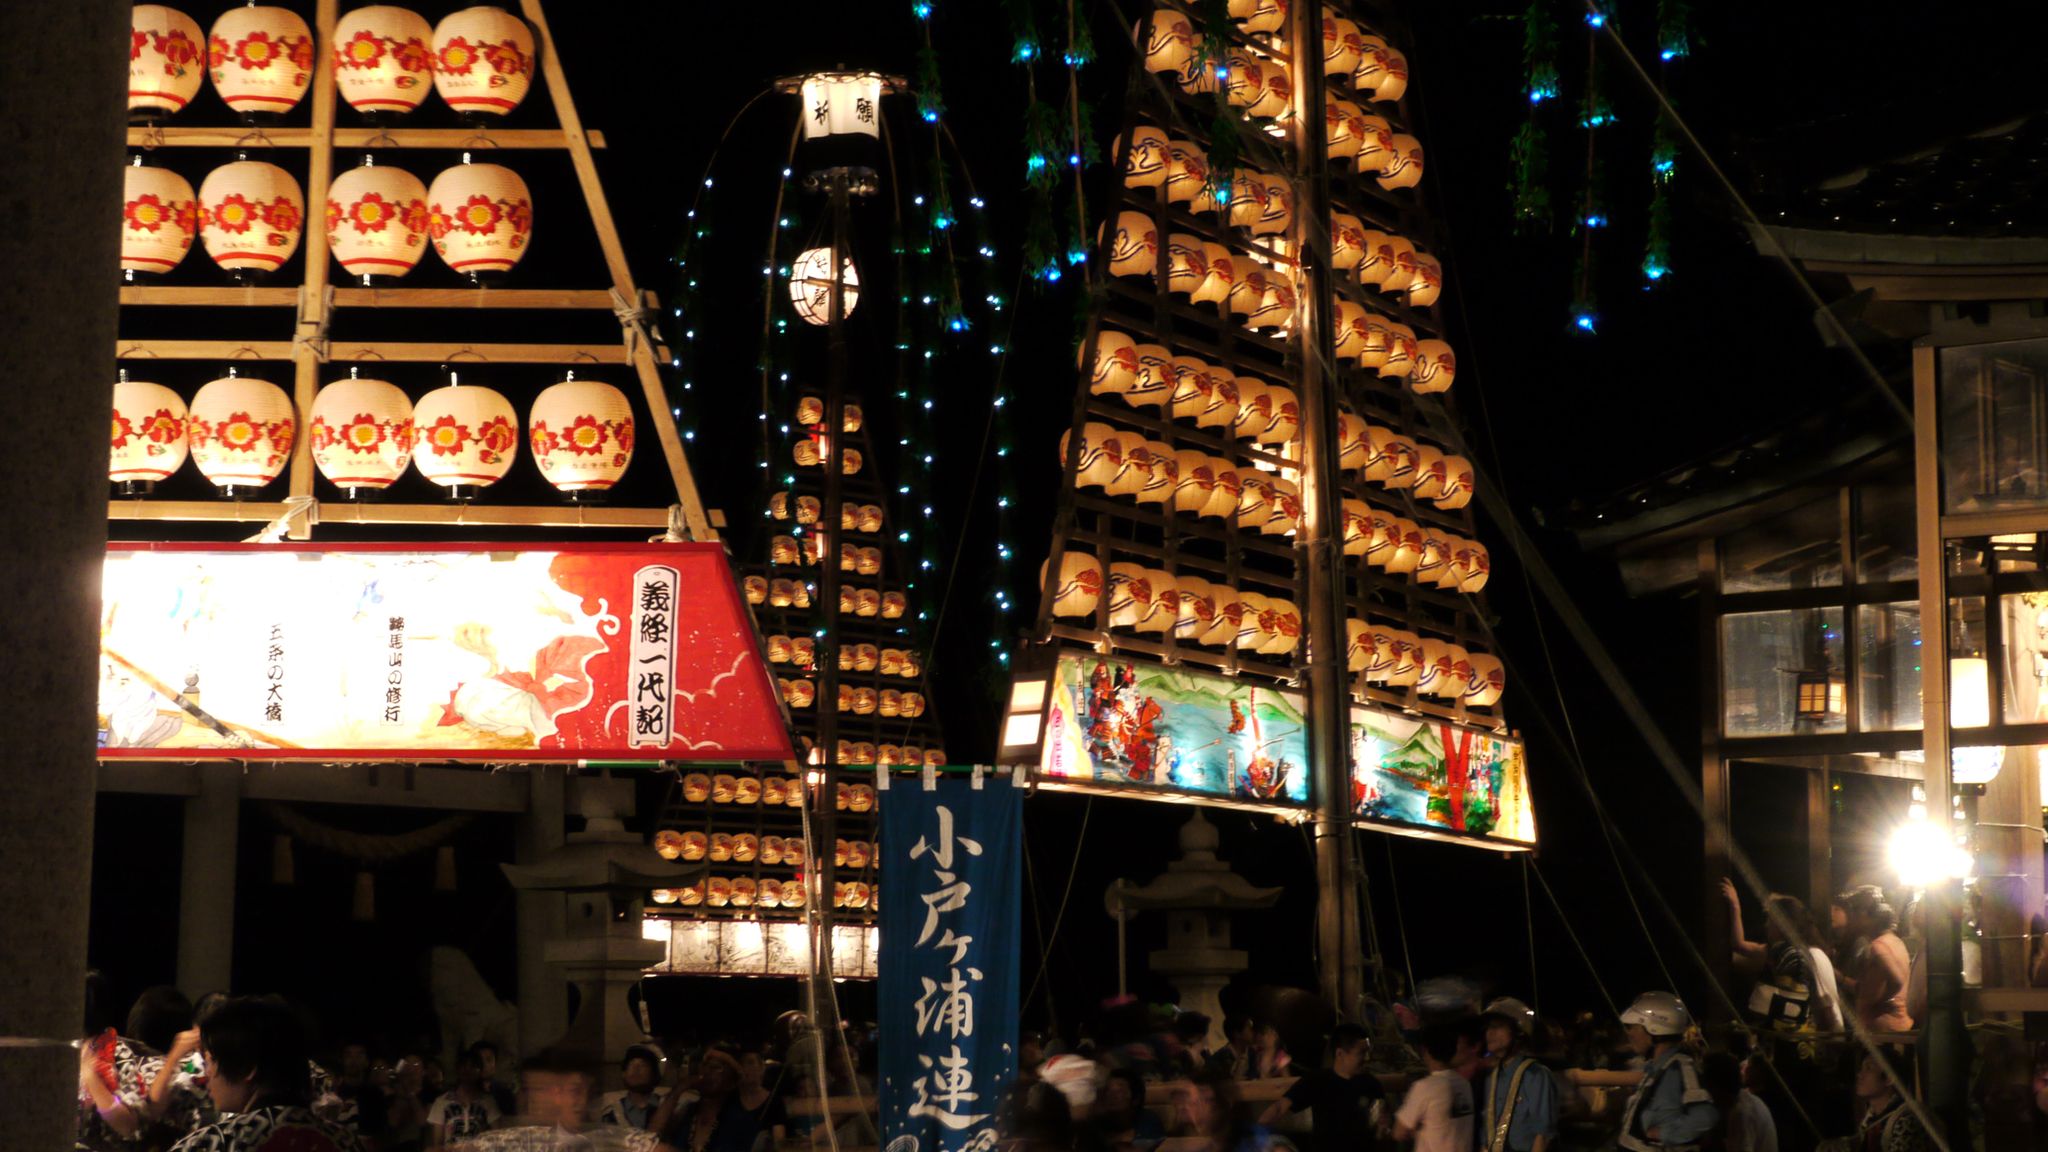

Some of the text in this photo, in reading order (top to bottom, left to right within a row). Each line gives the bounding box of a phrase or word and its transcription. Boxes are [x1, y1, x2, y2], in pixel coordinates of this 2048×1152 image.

[385, 616, 405, 722] 鞍馬山の修行
[636, 580, 671, 735] 義経一代記
